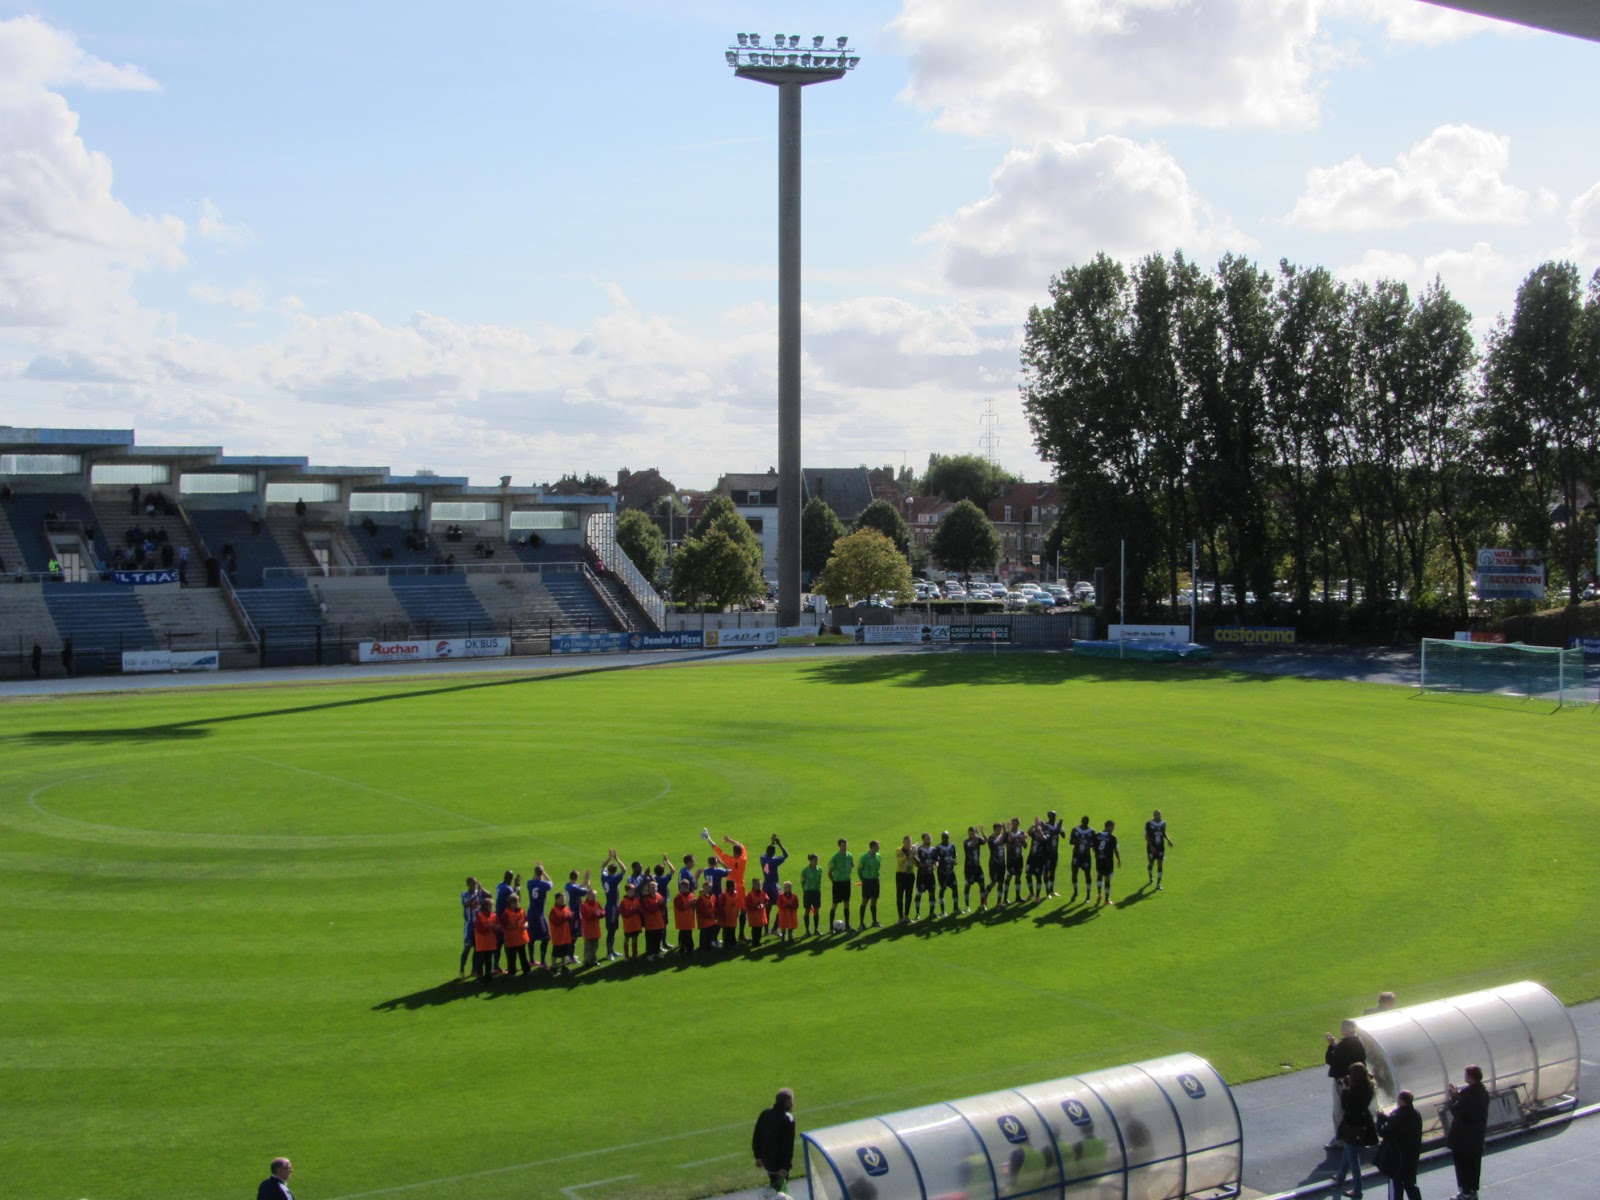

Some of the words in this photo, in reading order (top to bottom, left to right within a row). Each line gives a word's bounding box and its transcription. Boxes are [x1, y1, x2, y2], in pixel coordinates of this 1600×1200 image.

[643, 635, 680, 645] Domino's
[681, 634, 701, 643] Pizza
[1215, 627, 1295, 642] castorama
[370, 642, 419, 655] Auchan
[531, 887, 539, 899] 6
